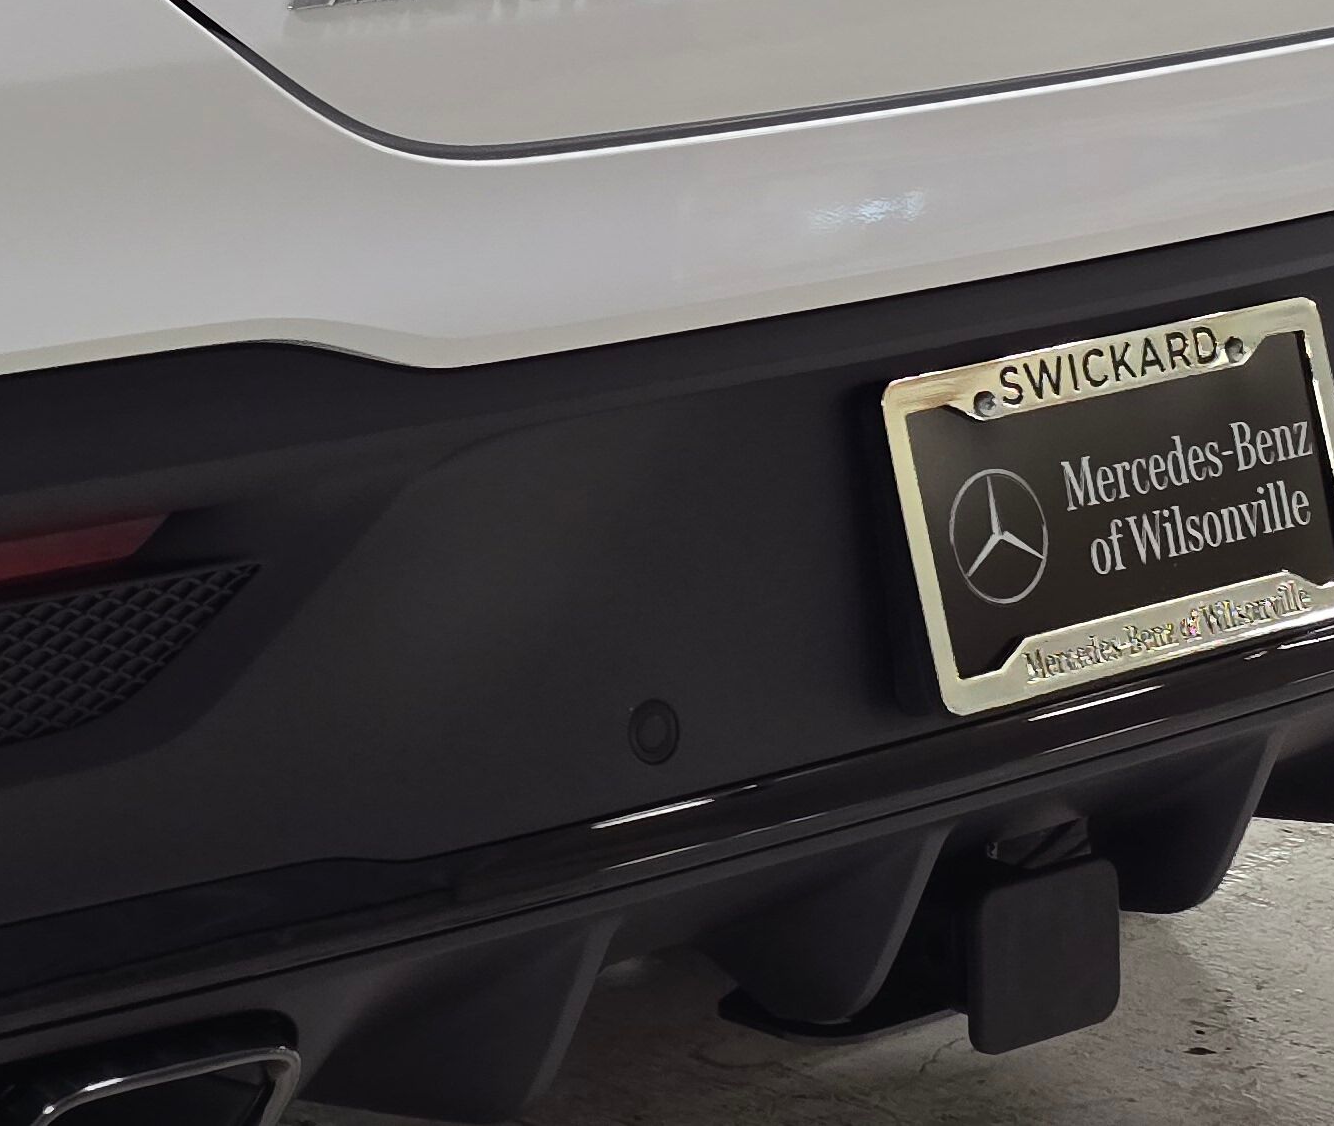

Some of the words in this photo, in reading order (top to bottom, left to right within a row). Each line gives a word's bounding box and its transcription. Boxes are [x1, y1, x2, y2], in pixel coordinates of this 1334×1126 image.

[1000, 326, 1218, 406] SWICKARD
[1060, 420, 1313, 511] Mercedes-Benz
[1090, 519, 1124, 575] of
[1124, 480, 1312, 566] Wilsonville
